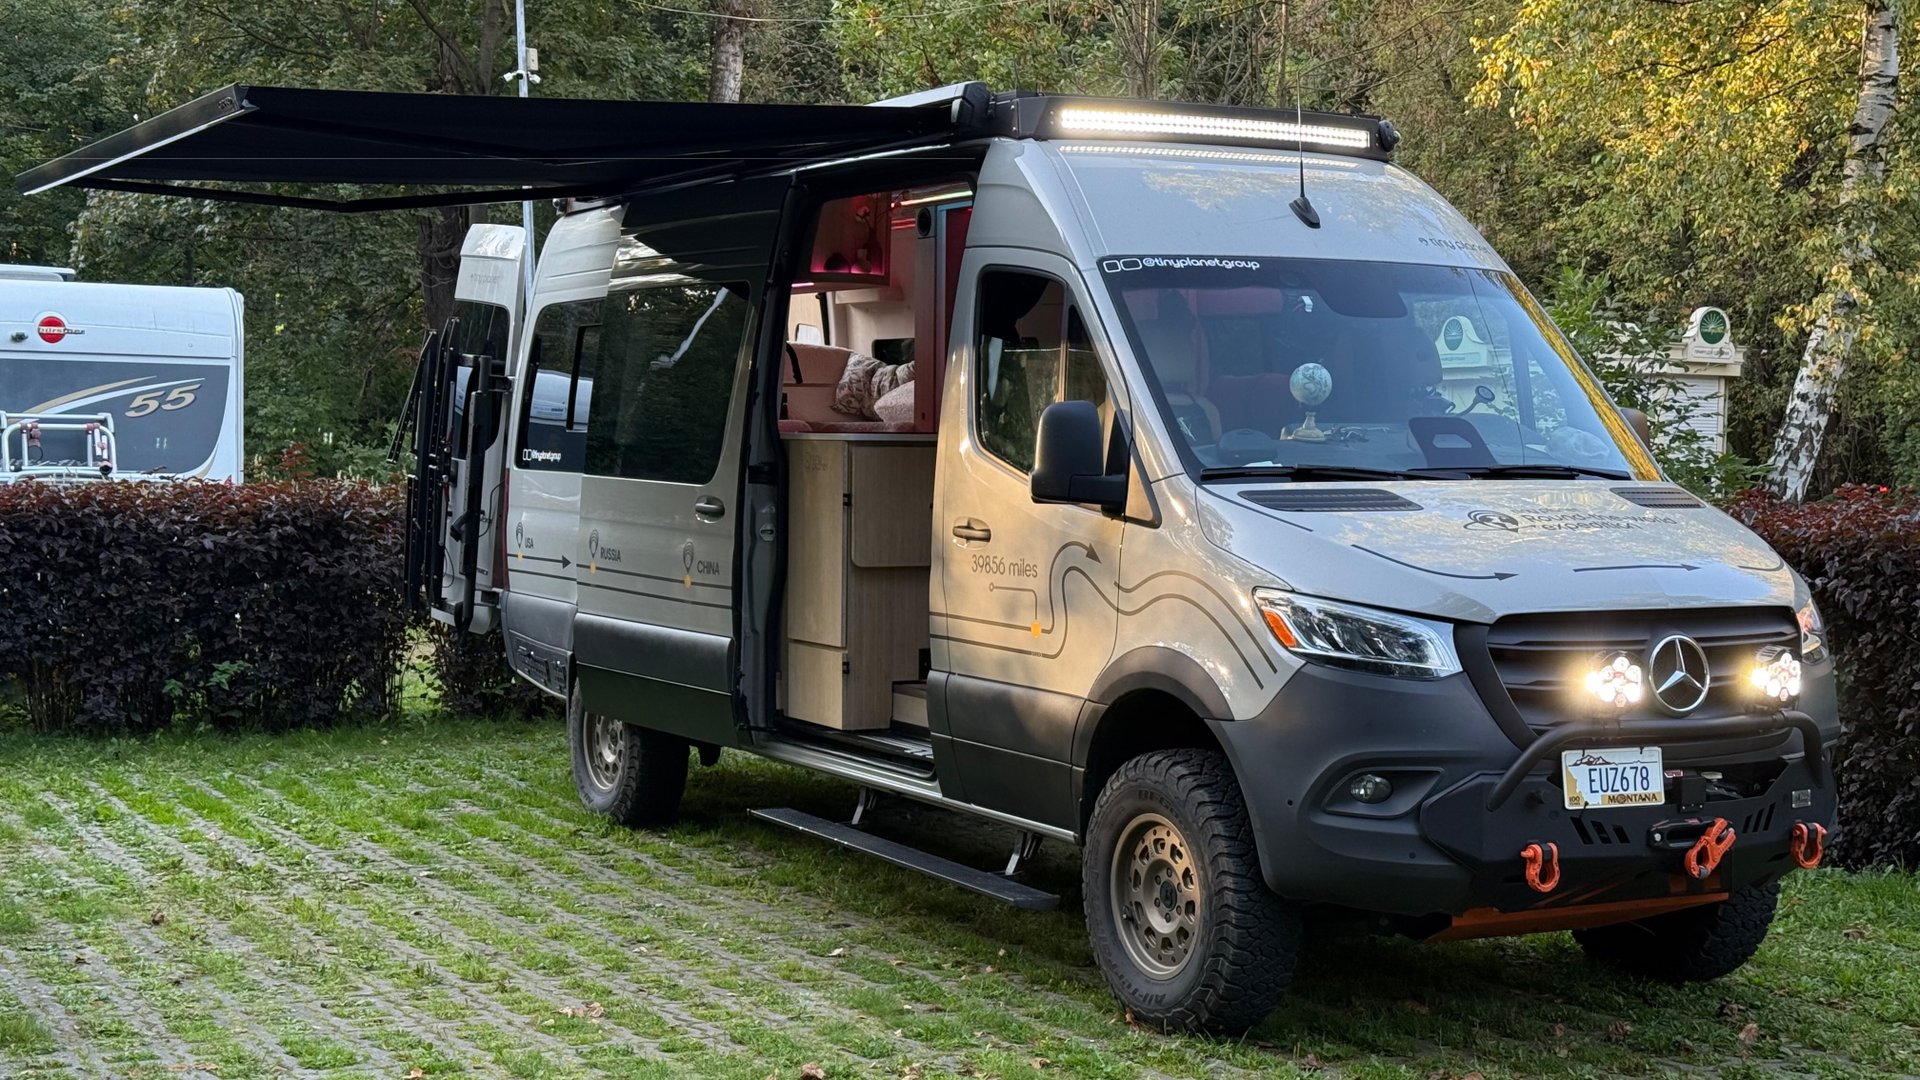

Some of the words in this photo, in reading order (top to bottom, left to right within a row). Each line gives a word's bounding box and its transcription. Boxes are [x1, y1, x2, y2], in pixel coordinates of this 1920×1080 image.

[1142, 256, 1261, 271] @tinyplanetgroup
[124, 383, 202, 418] 55
[524, 537, 534, 549] USA
[600, 546, 621, 563] RUSSIA
[697, 560, 720, 576] CHINA
[971, 554, 1006, 575] 39856
[1008, 558, 1038, 578] miles
[1588, 765, 1650, 794] EUZ678
[1607, 793, 1658, 805] MONTANA
